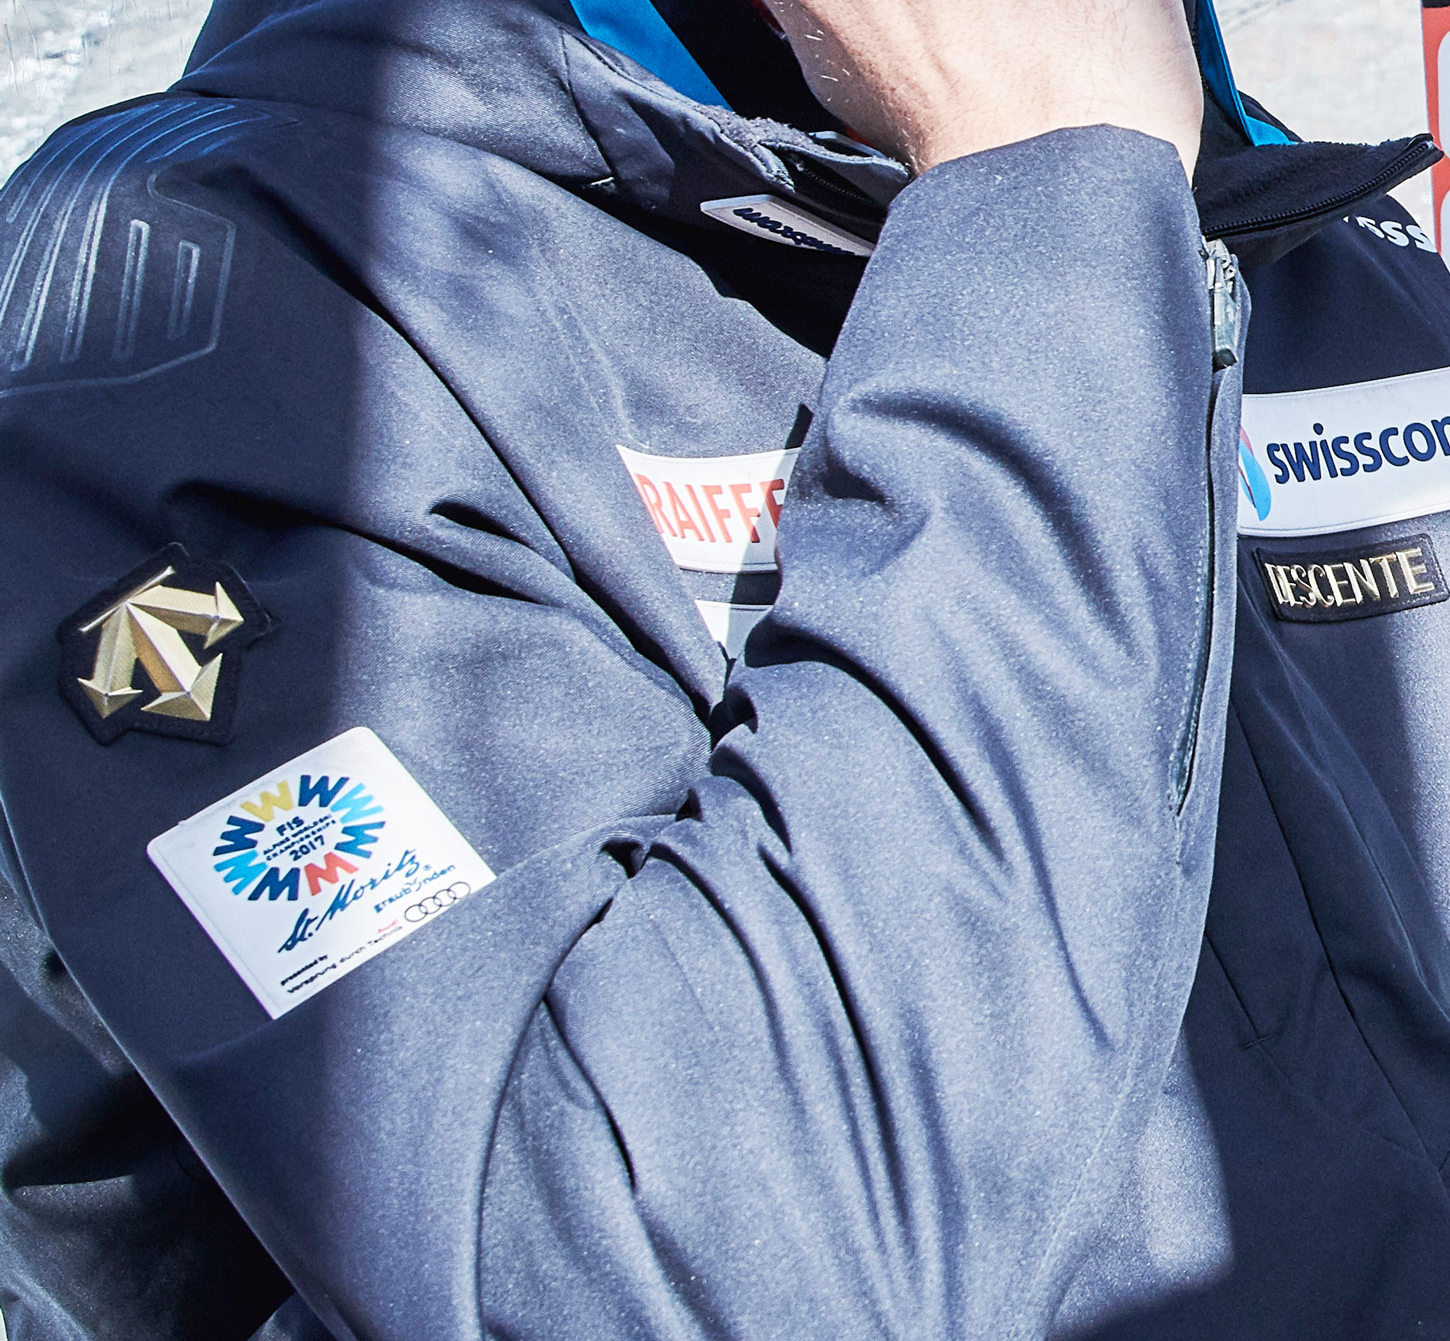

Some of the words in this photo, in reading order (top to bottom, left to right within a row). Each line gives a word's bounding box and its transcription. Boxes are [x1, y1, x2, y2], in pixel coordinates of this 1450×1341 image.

[1264, 546, 1436, 607] DESCENTE
[276, 815, 305, 837] FIS
[289, 834, 325, 862] 2017
[278, 907, 319, 953] St.
[315, 849, 420, 931] Moritz
